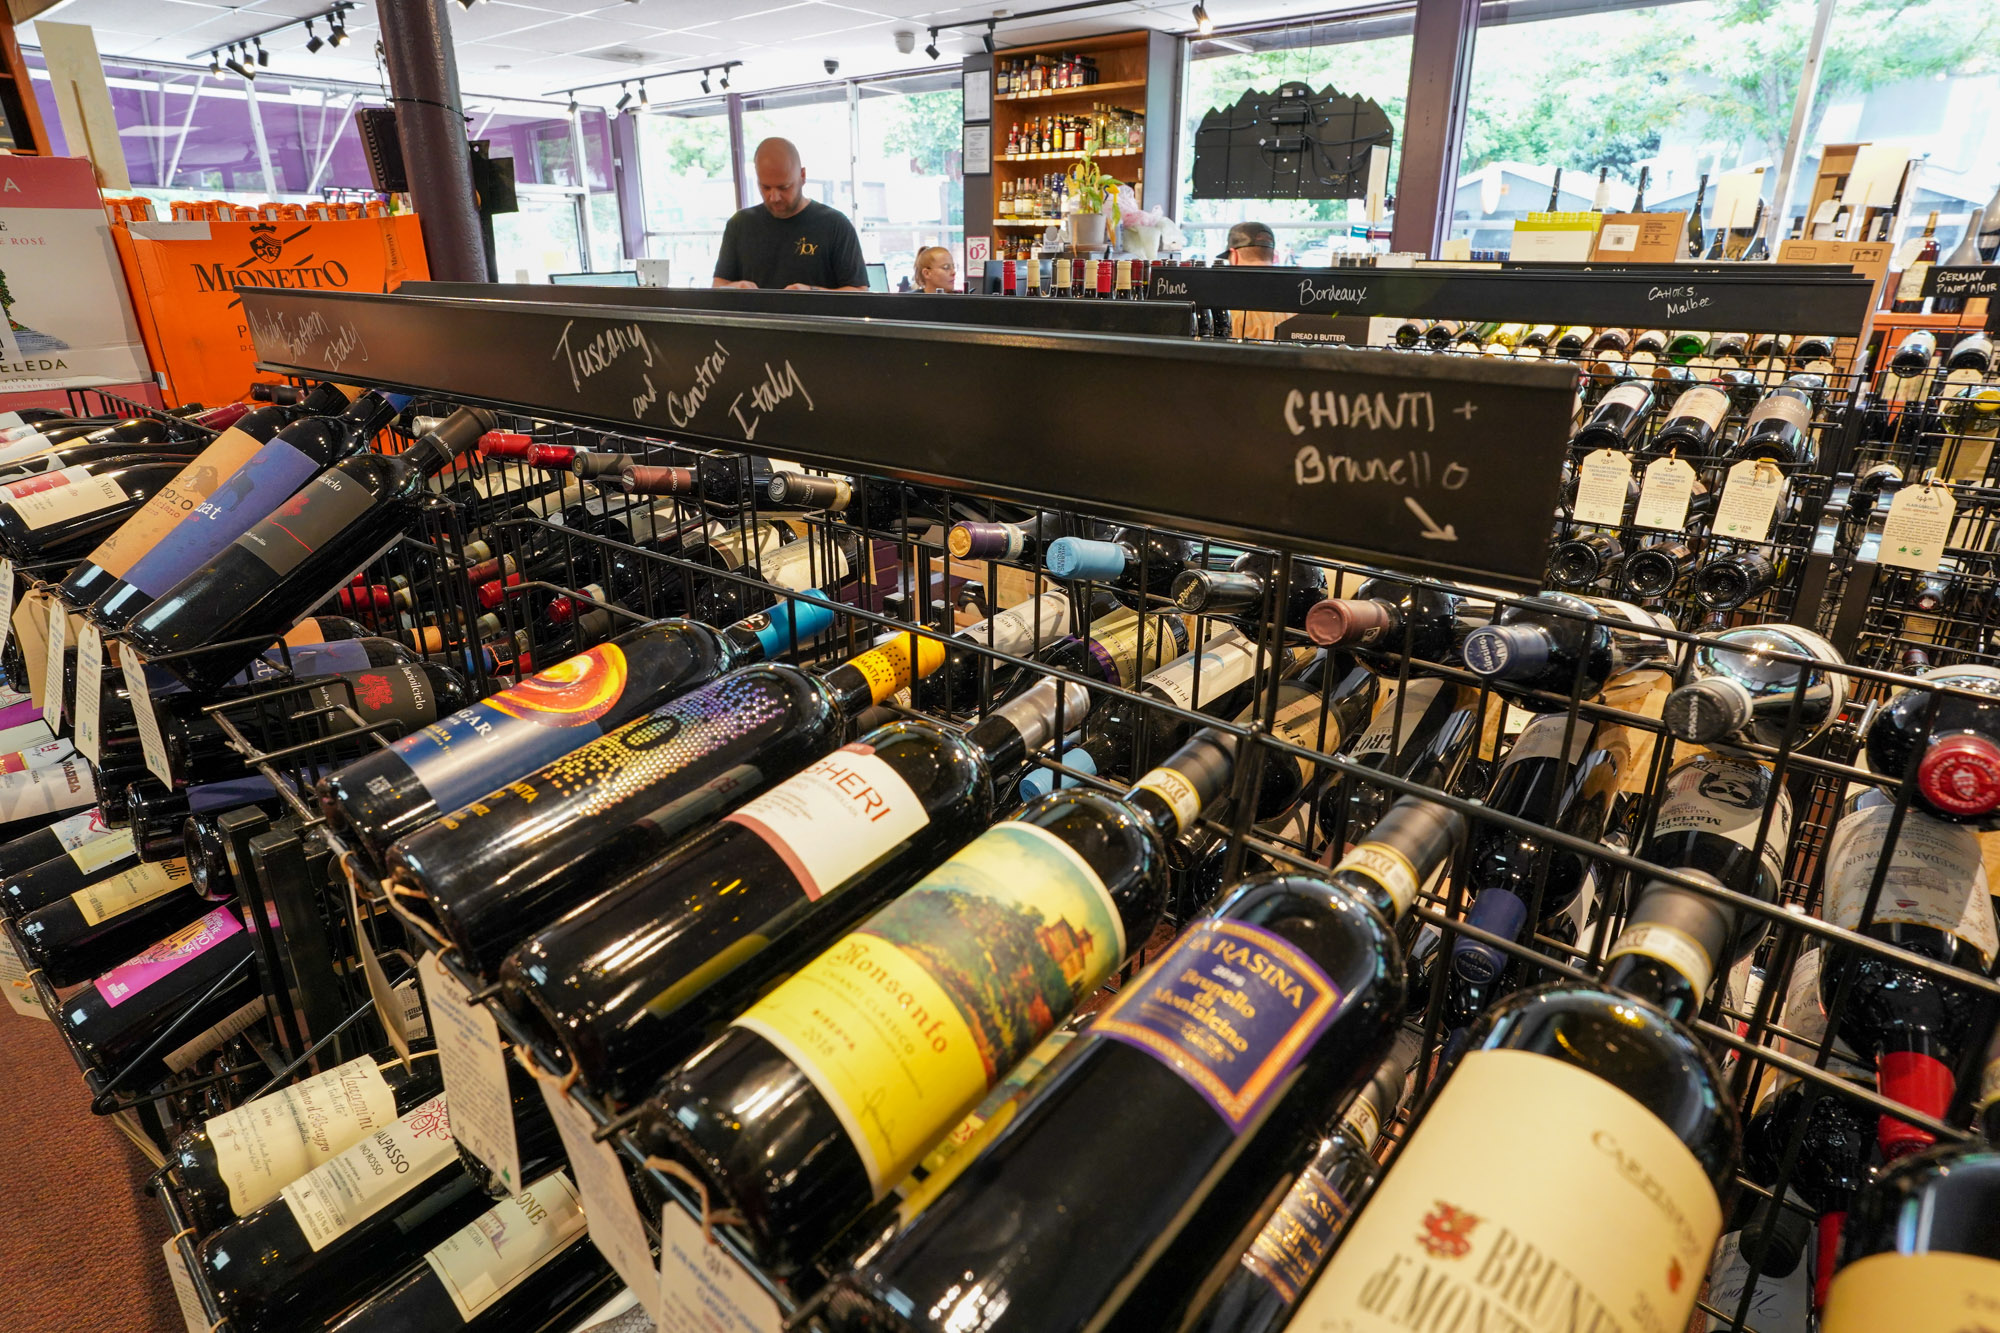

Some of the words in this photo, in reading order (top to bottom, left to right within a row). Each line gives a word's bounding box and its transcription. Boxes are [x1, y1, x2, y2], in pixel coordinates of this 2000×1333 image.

[190, 259, 348, 293] MIONETTO
[1156, 278, 1188, 296] Blanc
[1300, 278, 1368, 306] Bordeaux
[1936, 283, 1967, 295] PINOT
[1970, 281, 1998, 294] NOIR
[1937, 270, 1986, 284] GERMAN
[324, 322, 369, 372] Italy
[553, 318, 653, 393] Tuscany
[1291, 332, 1311, 341] BREAD
[1320, 333, 1346, 342] BUTTER
[632, 372, 658, 420] and
[666, 339, 731, 428] Central
[727, 358, 815, 441] Italy
[1284, 389, 1434, 436] CHIANTI
[1295, 445, 1469, 490] Brunello
[828, 941, 947, 1054] Monsanto
[1180, 968, 1256, 1019] Brunello
[1212, 939, 1304, 1009] RASINA
[1152, 986, 1249, 1052] Montalcino
